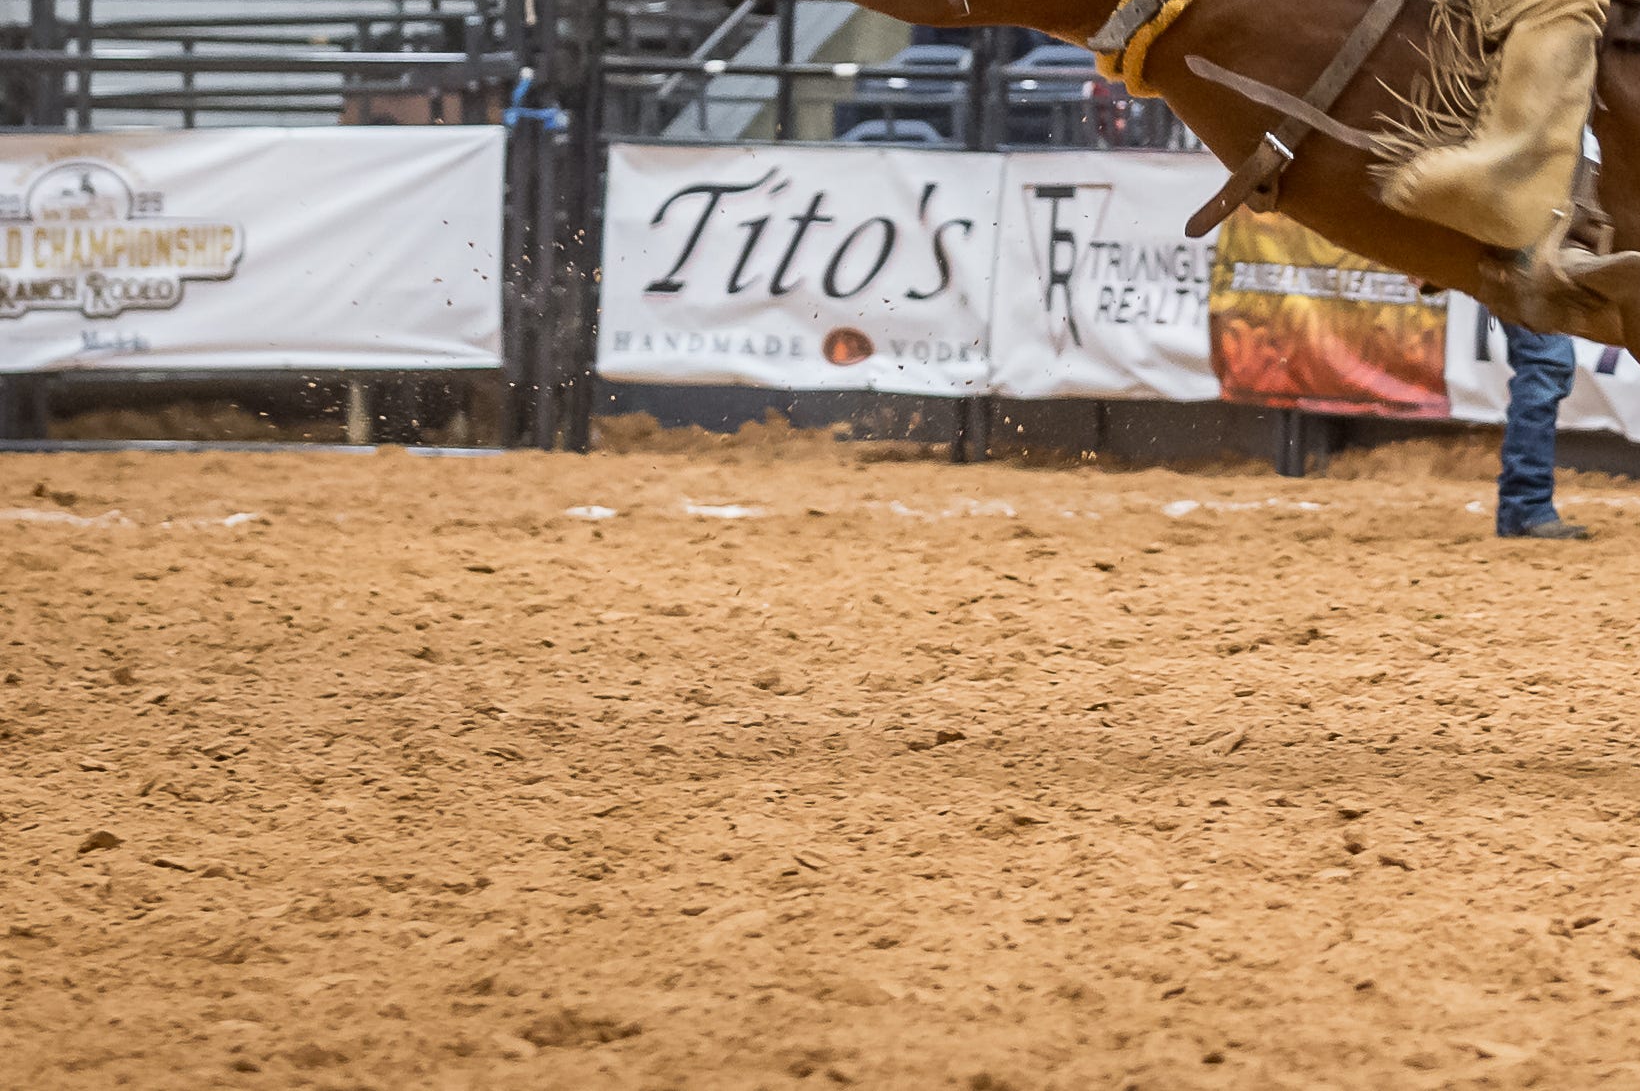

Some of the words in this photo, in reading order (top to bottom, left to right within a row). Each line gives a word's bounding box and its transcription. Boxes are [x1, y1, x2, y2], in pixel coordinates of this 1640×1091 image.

[33, 224, 234, 269] CHAMPIONSHIP
[84, 270, 174, 308] RODEO
[613, 329, 804, 359] HANDMADE
